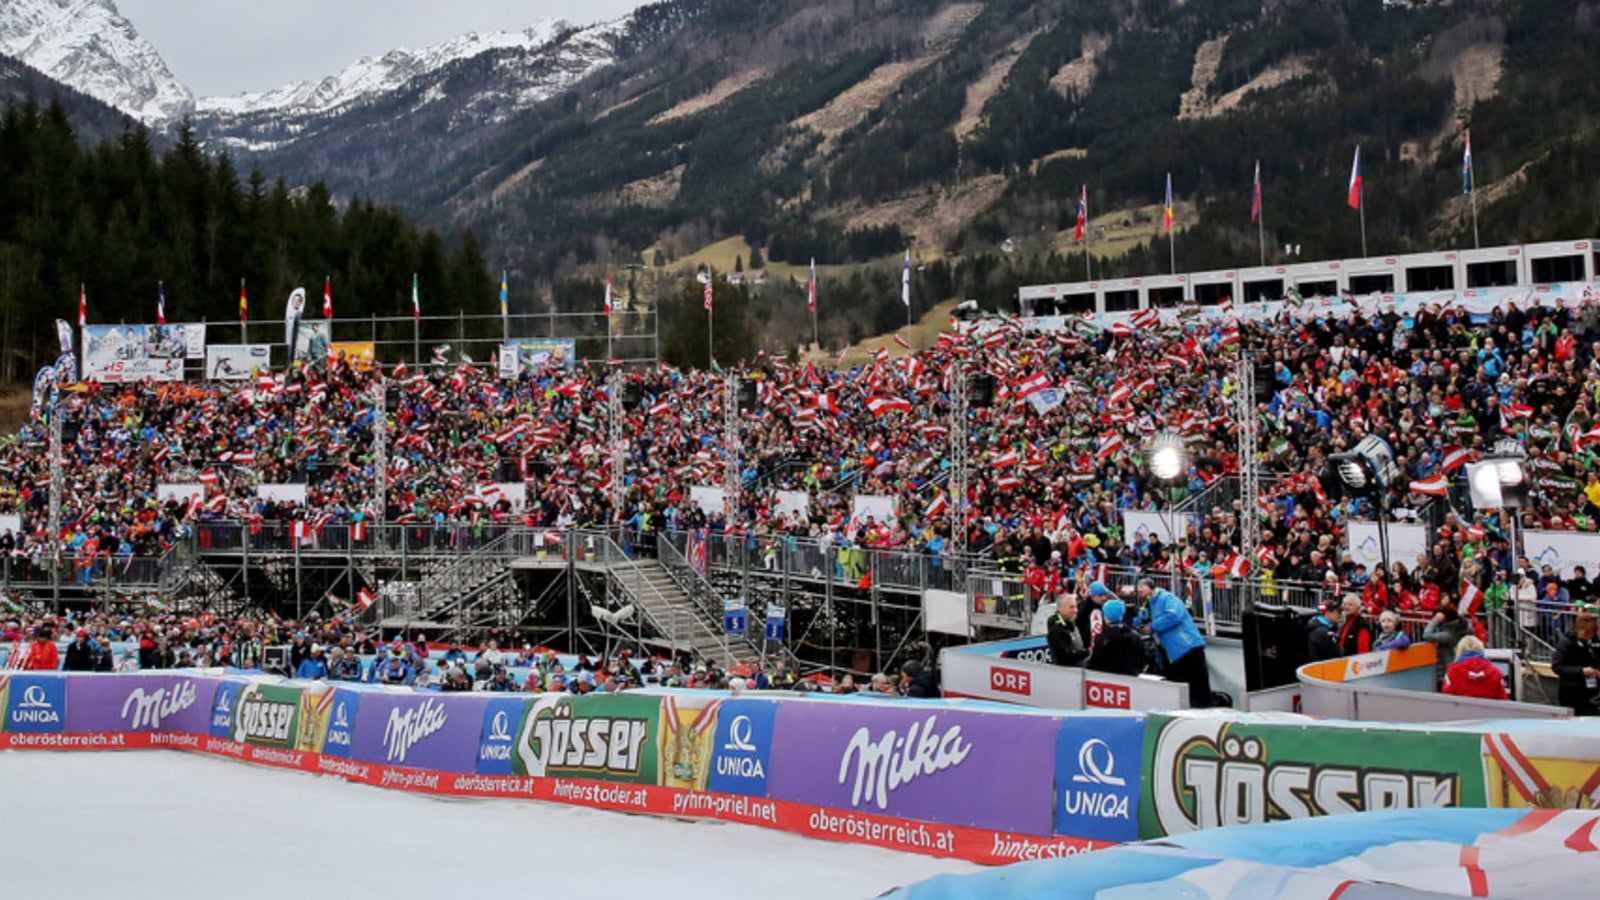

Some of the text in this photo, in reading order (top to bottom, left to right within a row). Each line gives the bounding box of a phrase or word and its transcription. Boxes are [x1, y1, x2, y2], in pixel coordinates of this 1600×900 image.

[993, 672, 1028, 689] ORF
[1088, 687, 1127, 706] ORF
[12, 710, 59, 722] UNIQA
[10, 733, 125, 746] oberösterreich.at
[383, 697, 448, 762] Milka
[518, 694, 648, 777] Gösser
[481, 745, 512, 760] UNIQA
[839, 715, 972, 809] Milka
[717, 757, 765, 778] UNIQA
[454, 776, 534, 795] oberösterreich.at
[553, 779, 647, 807] hinterstoder.at
[673, 792, 777, 824] pyhrn-priel.net
[1065, 790, 1129, 819] UNIQA
[809, 810, 954, 853] oberösterreich.at
